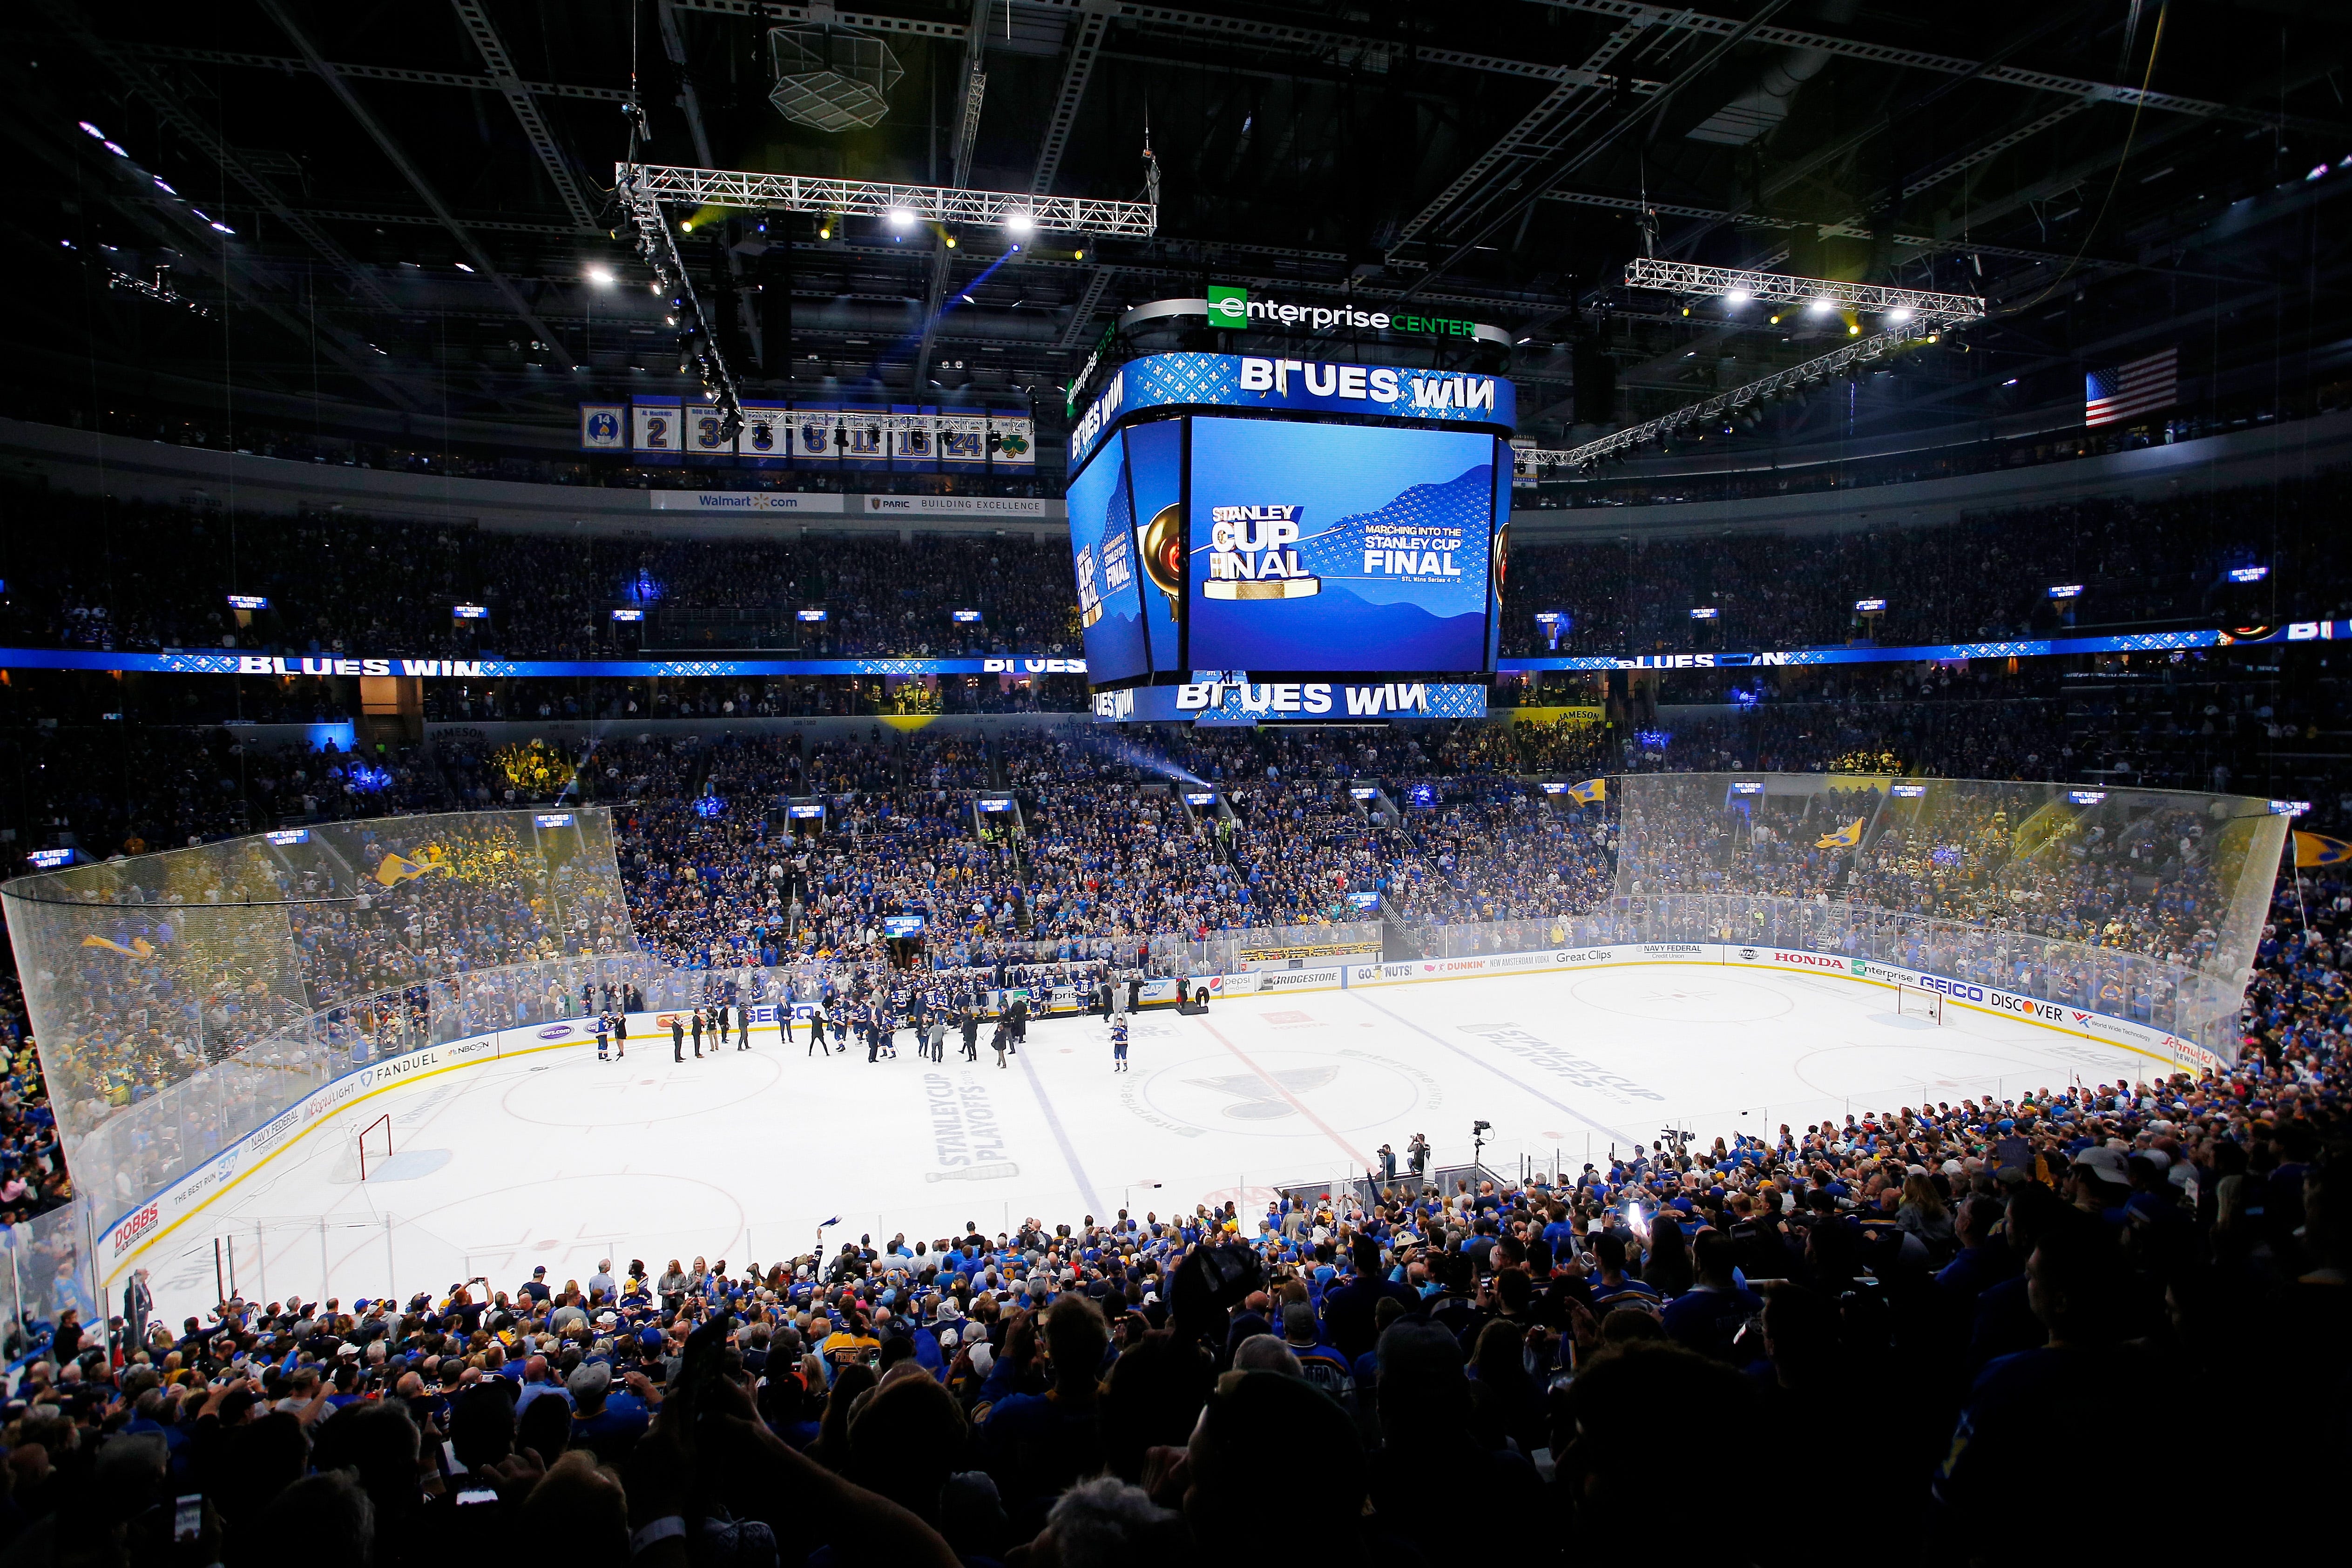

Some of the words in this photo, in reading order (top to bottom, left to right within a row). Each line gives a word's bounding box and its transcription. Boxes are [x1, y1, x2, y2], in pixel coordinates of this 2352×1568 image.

[1208, 298, 1390, 329] enterprise
[1391, 315, 1475, 337] CENTER
[1067, 351, 1097, 405] enterprise
[598, 415, 610, 423] 14
[647, 417, 668, 448] 2
[699, 418, 723, 449] 3
[947, 427, 982, 456] 24
[699, 495, 751, 508] Walmart
[883, 500, 910, 508] PARIC
[921, 500, 971, 508] BUILDING
[977, 501, 1040, 510] EXCELLENCE
[1212, 505, 1295, 522] STANLEY
[1211, 520, 1299, 553] CUP
[1365, 525, 1418, 535] MARCHING
[1418, 527, 1441, 536] INTO
[1442, 528, 1462, 537] THE
[1365, 536, 1430, 550] STANLEY
[1432, 538, 1461, 551] CUP
[1210, 550, 1310, 579] FINAL
[1364, 550, 1462, 576] FINAL
[1105, 557, 1130, 590] FINAL
[239, 656, 391, 676] BLUES
[402, 659, 482, 677] WIN
[1558, 710, 1600, 720] JAMESON
[429, 727, 486, 742] JAMESON
[1490, 959, 1501, 967] NEW
[1501, 956, 1534, 967] AMSTERDAM
[1535, 955, 1550, 964] VODKA
[1556, 953, 1586, 963] Great
[1588, 950, 1611, 960] Clips
[1739, 950, 1759, 958] NHL
[1774, 952, 1845, 969] HONDA
[1358, 968, 1371, 979] GO
[1386, 965, 1413, 977] NUTS!
[1447, 960, 1486, 971] DUNKIN'
[1852, 963, 1913, 983] enterprise
[1046, 979, 1053, 988] 19
[1080, 984, 1088, 992] 18
[1225, 975, 1250, 987] pepsi
[1272, 972, 1338, 985] BRIDGESTONE
[928, 994, 936, 1004] 91
[1143, 985, 1163, 995] SAP
[1919, 976, 1983, 1002] GEICO
[1991, 993, 2063, 1022] DISCOVER
[540, 1027, 571, 1037] cars.com
[2091, 1020, 2107, 1028] World
[2122, 1028, 2150, 1042] Technology
[457, 1041, 489, 1054] NBCSN
[377, 1052, 439, 1081] FANDUEL
[1476, 1033, 1604, 1088] PLAYOFFS
[1593, 1088, 1632, 1106] 2019
[1498, 1029, 1614, 1075] STANLEY
[1598, 1075, 1666, 1101] CUP
[923, 1073, 954, 1098] CUP
[960, 1070, 975, 1085] 2019
[1337, 1049, 1432, 1083] enterprise
[1426, 1078, 1443, 1110] CENTER
[310, 1095, 332, 1116] Coors
[331, 1082, 355, 1102] LIGHT
[251, 1128, 270, 1148] NAVY
[271, 1109, 299, 1135] FEDERAL
[928, 1098, 972, 1166] STANLEY
[958, 1086, 1008, 1161] PLAYOFFS
[259, 1139, 274, 1155] Credit
[274, 1131, 287, 1146] Union
[174, 1192, 187, 1205] THE
[188, 1181, 203, 1196] BEST
[204, 1171, 216, 1186] RUN
[219, 1155, 236, 1177] SAP
[115, 1202, 158, 1249] DOBBS
[1003, 1268, 1015, 1284] 9
